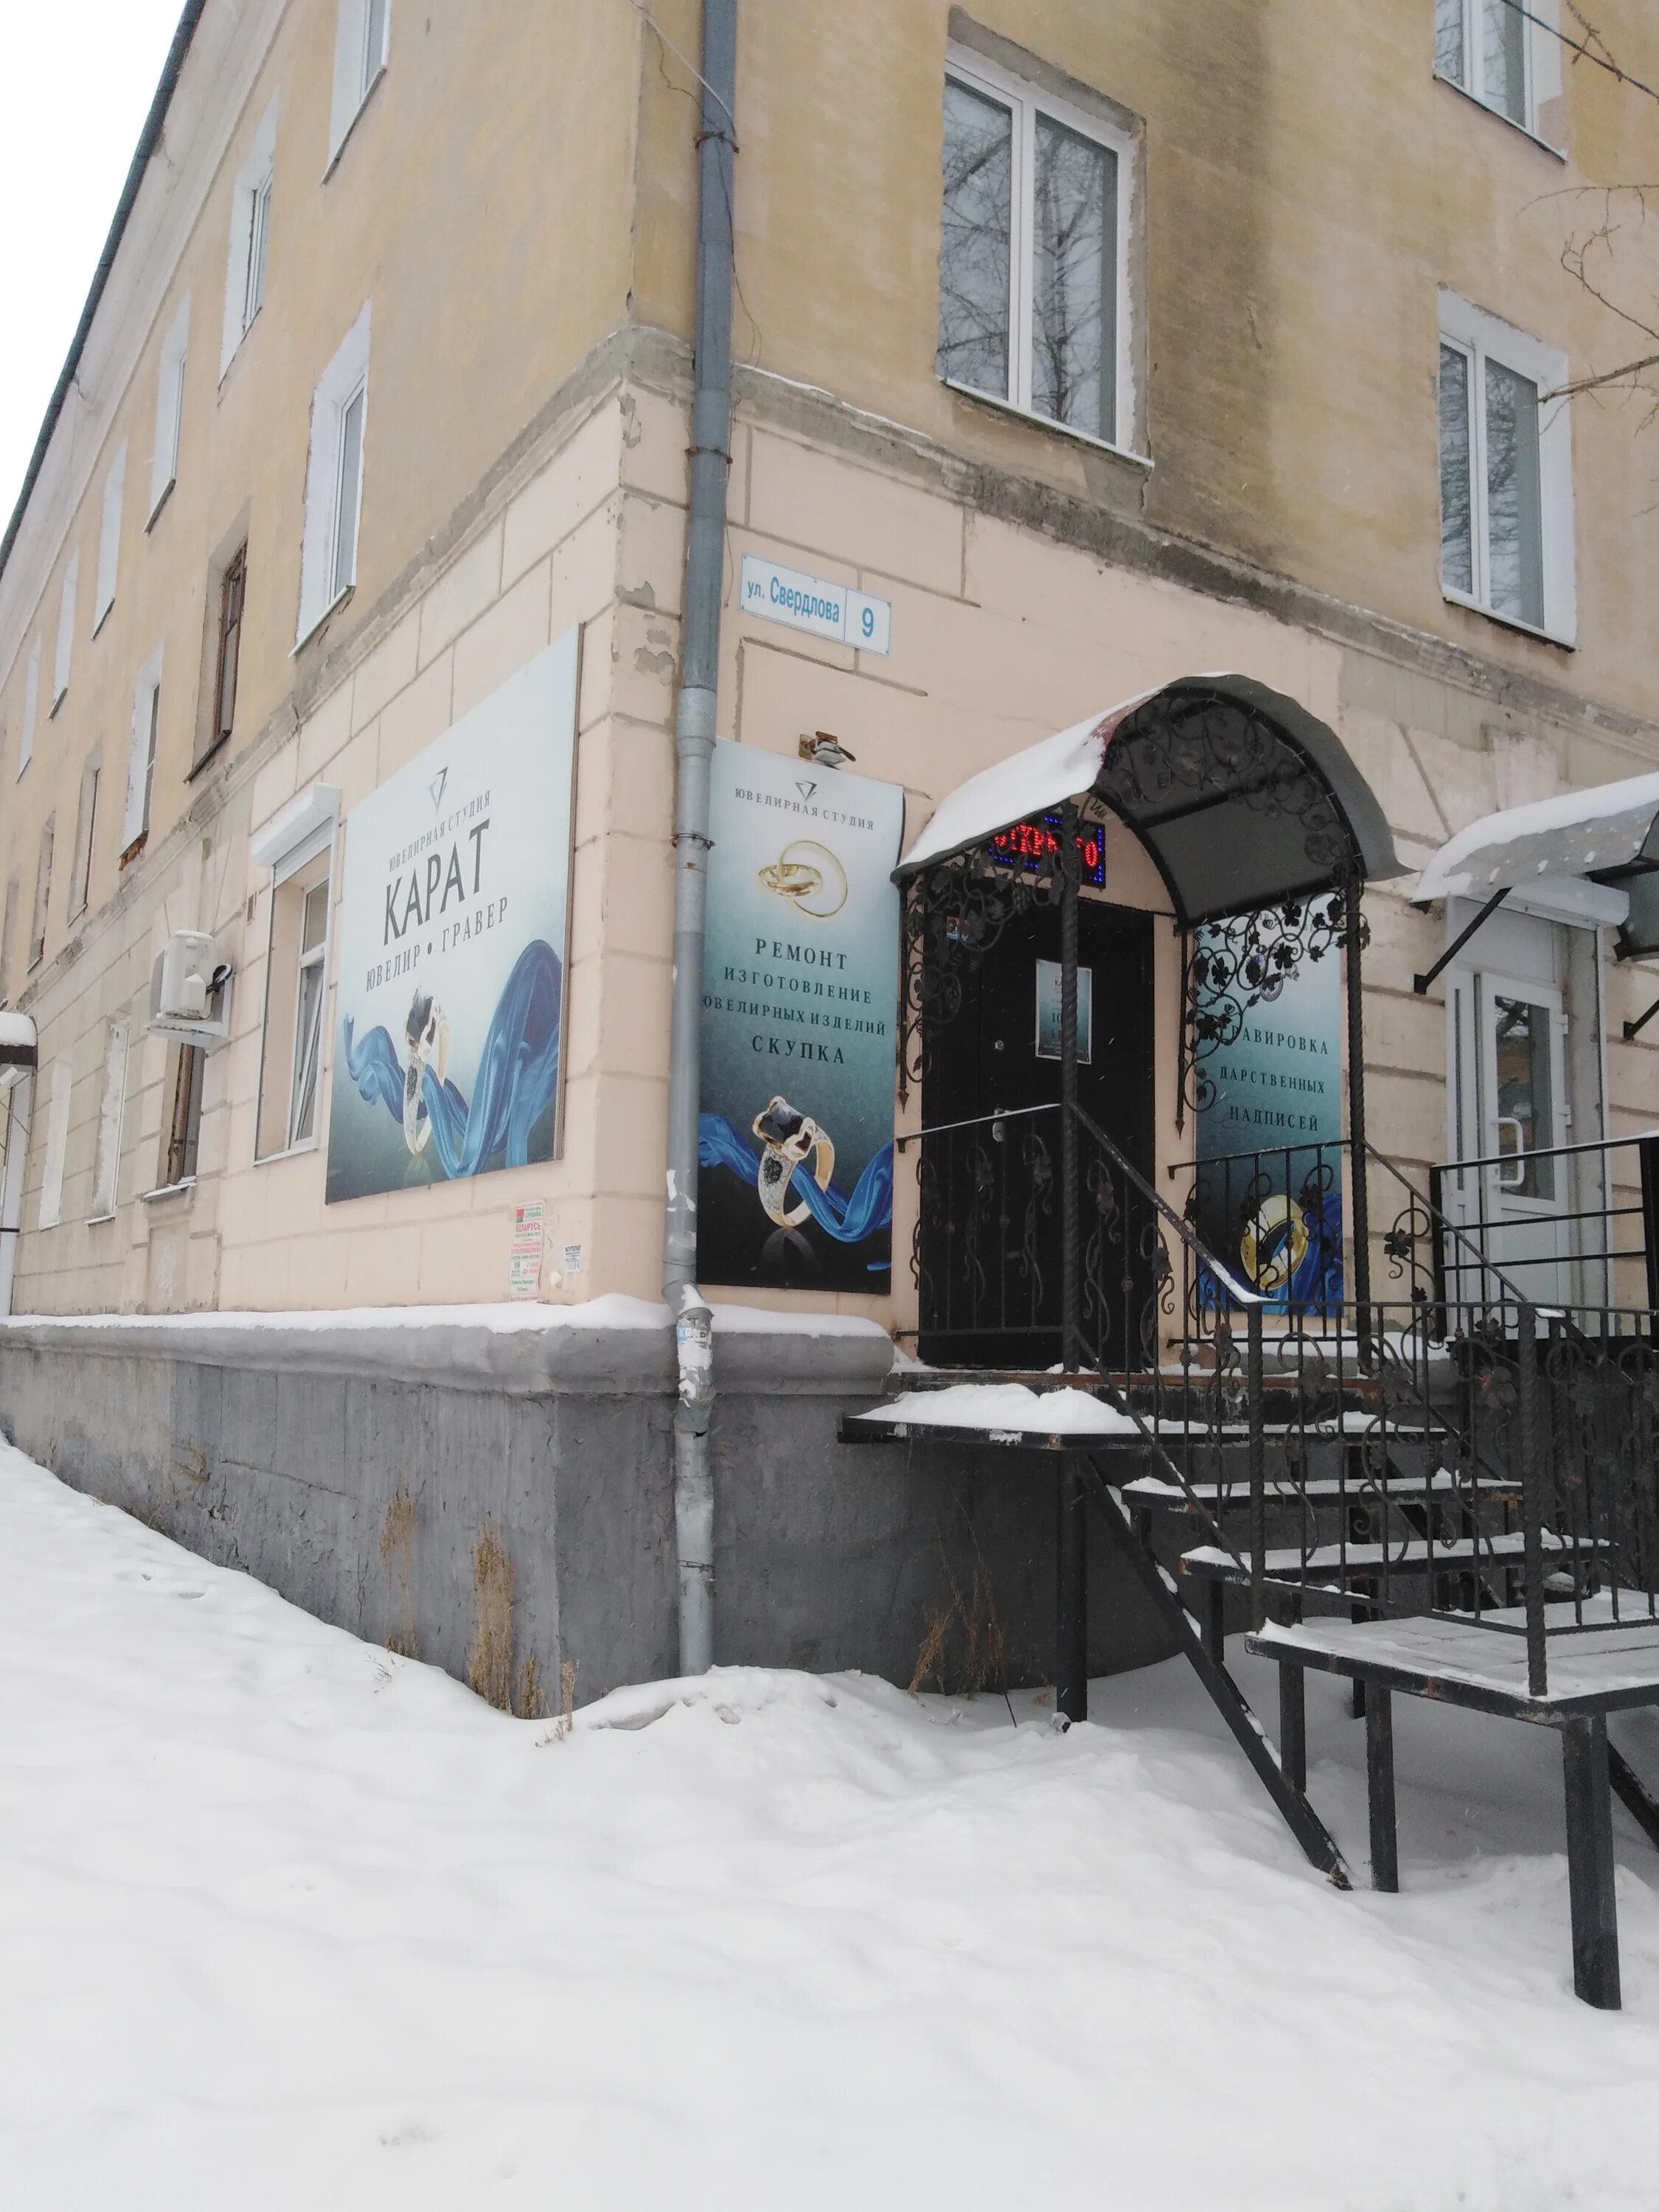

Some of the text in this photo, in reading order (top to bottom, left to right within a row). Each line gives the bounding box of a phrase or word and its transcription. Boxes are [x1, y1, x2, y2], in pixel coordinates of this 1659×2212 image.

[747, 577, 874, 638] ул. Свердлова 9
[734, 787, 874, 832] ЮВЕЛИРНАЯ СТУДИЯ
[389, 790, 491, 872] ЮВЕЛИРНАЯ СТУДИЯ
[383, 817, 491, 946] КАРАТ
[366, 897, 508, 992] ЮВЕЛИР ГРАВЕР
[755, 937, 848, 970] РЕМОНТ
[724, 967, 872, 1004] ИЗГОТОВЛЕНИЕ
[810, 1012, 886, 1036] ИЗДЕЛИЙ
[752, 1034, 845, 1065] СКУПКА
[1220, 1066, 1325, 1094] ДАРСТВЕННЫХ
[1230, 1106, 1318, 1131] НАДПИСЕЙ
